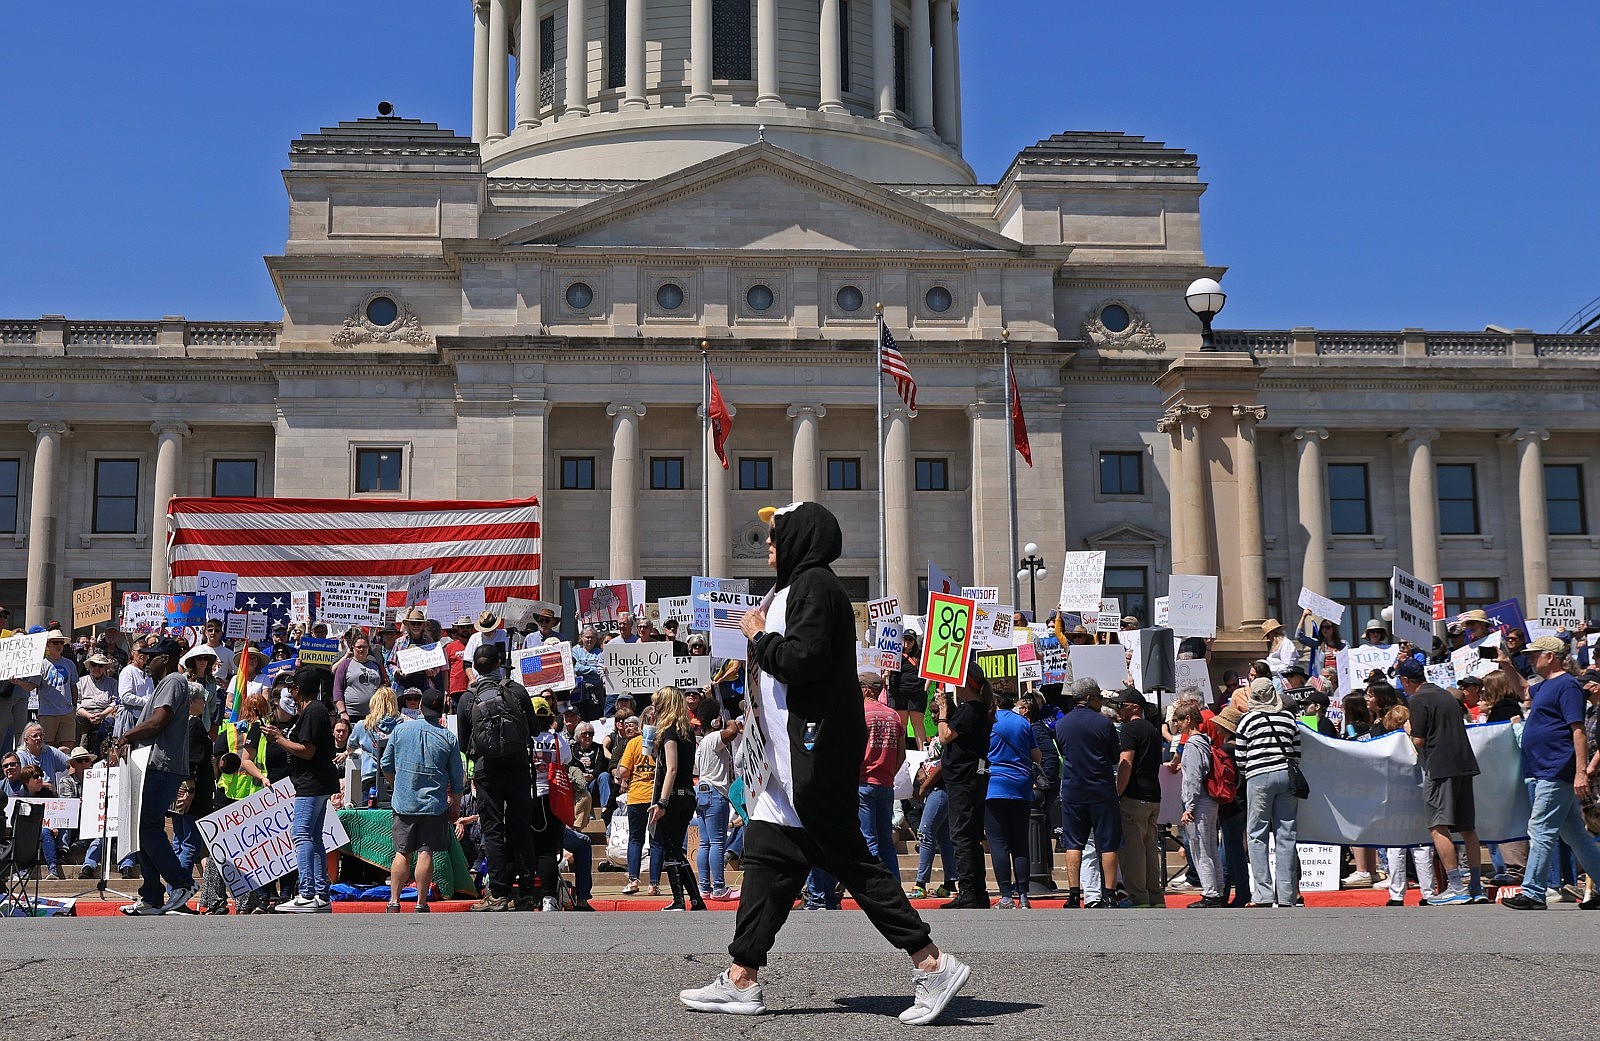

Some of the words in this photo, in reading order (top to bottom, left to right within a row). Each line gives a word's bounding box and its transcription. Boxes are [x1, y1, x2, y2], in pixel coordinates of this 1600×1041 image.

[698, 580, 715, 588] THIS
[1399, 574, 1414, 590] RAISE
[76, 586, 107, 604] RESIST
[364, 591, 385, 600] BITCH!
[431, 591, 478, 604] DEMOCRACY
[710, 592, 741, 605] SAVE
[962, 588, 983, 599] HANDS
[984, 589, 996, 600] OFF
[328, 601, 368, 612] PRESIDENT!
[450, 601, 470, 612] DIES
[669, 598, 688, 607] TRUMP
[870, 598, 898, 620] STOP
[1394, 589, 1402, 601] SO
[1404, 593, 1433, 616] DEMOCRACY
[1548, 597, 1572, 608] LIAR
[75, 604, 111, 621] TYRANNY
[354, 614, 373, 623] ELON!
[1544, 607, 1576, 617] FELON
[938, 605, 968, 642] 86
[1420, 618, 1430, 632] FAIL
[882, 627, 897, 638] NO
[878, 638, 902, 652] KINGS
[6, 650, 33, 661] FIRST
[609, 653, 644, 666] Hands
[676, 657, 692, 665] EAT
[934, 642, 963, 676] 47
[1354, 651, 1391, 664] TURD
[626, 666, 649, 677] FREE
[978, 655, 1005, 678] OVER
[1007, 653, 1016, 677] IT
[1466, 658, 1482, 674] OFF
[622, 677, 660, 688] SPEECH!
[675, 677, 698, 687] REICH
[198, 784, 297, 844] DIABOLICAL
